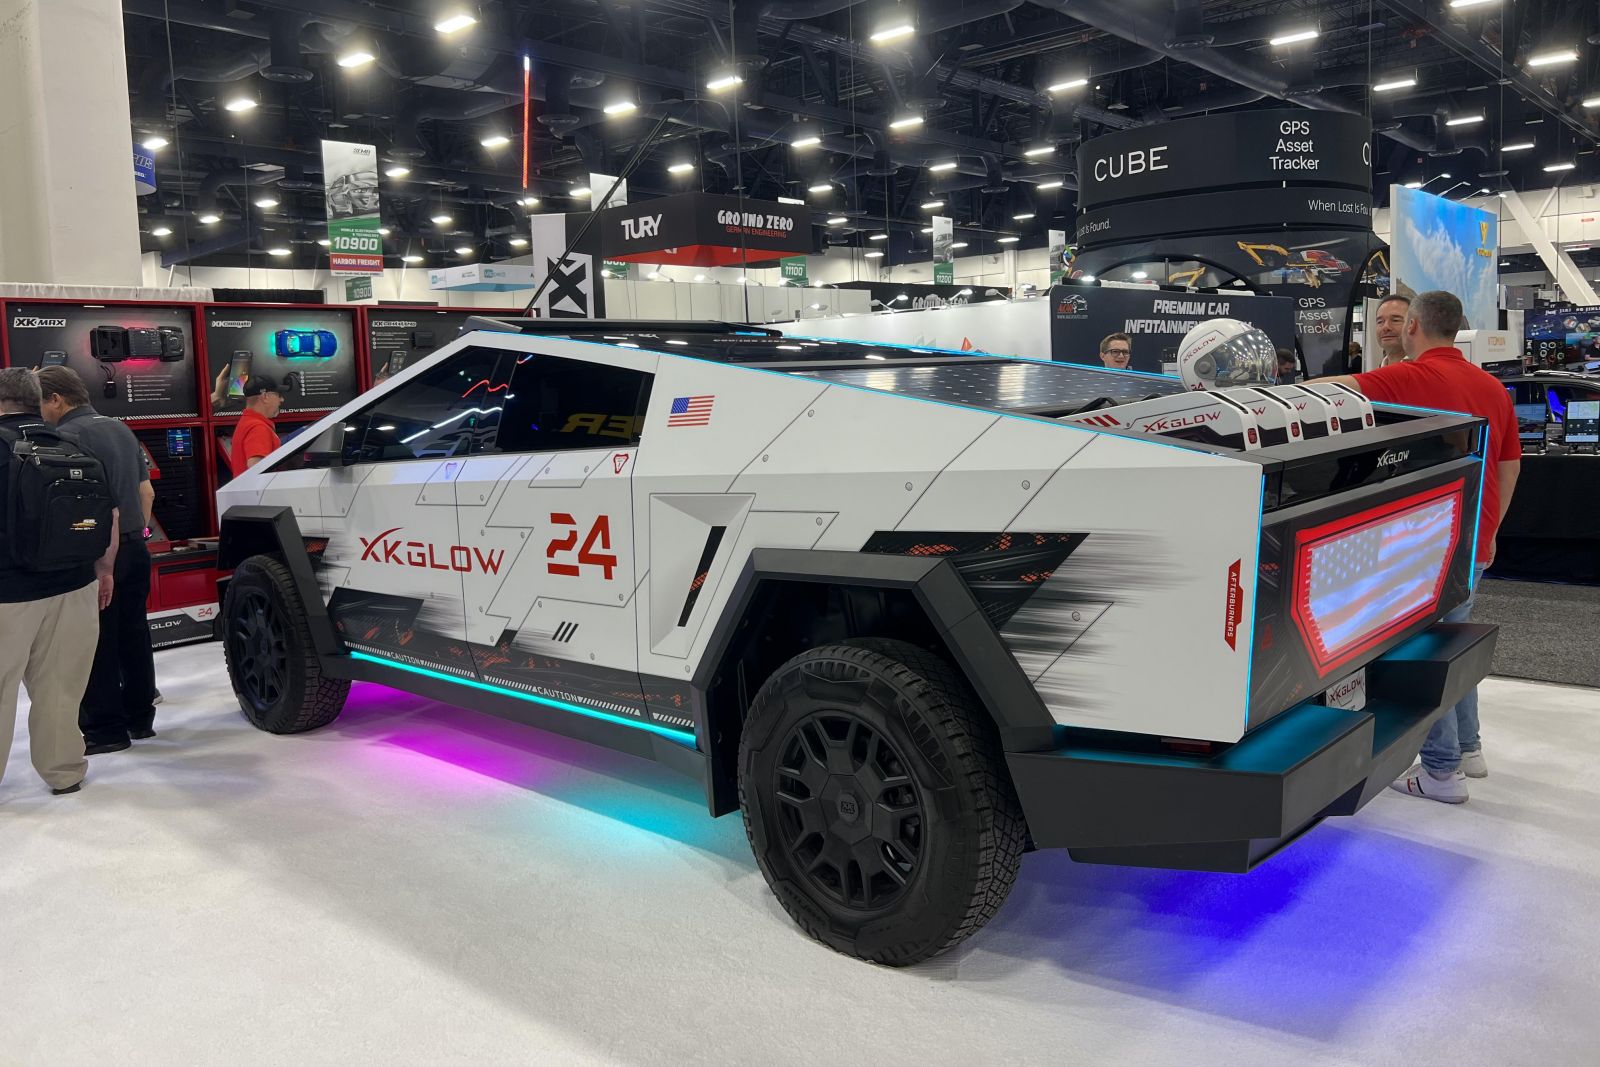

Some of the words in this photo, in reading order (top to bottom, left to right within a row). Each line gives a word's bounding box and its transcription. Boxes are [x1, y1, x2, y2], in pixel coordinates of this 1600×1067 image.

[1280, 121, 1310, 135] GPS
[1275, 138, 1314, 153] Asset
[1094, 145, 1169, 182] CUBE
[1269, 155, 1320, 171] Tracker
[1308, 199, 1336, 212] When
[1338, 201, 1354, 214] Lost
[621, 213, 663, 241] TURY
[717, 210, 763, 228] GROUND
[766, 214, 794, 231] ZERO
[1090, 218, 1112, 232] Found.
[334, 236, 378, 251] 10900
[332, 257, 357, 265] HARBOR
[784, 265, 803, 276] 11100
[1153, 299, 1206, 316] PREMIUM
[1207, 302, 1230, 316] CAR
[1298, 297, 1326, 308] GPS
[1299, 309, 1334, 321] Asset
[1295, 322, 1342, 334] Tracker
[1143, 410, 1222, 433] XKGLOW
[1376, 449, 1410, 468] XKGLOW
[359, 526, 505, 576] XKGLOW
[546, 512, 618, 581] 24
[1227, 571, 1237, 637] AFTERBURNERS
[198, 607, 213, 617] 24
[150, 620, 181, 630] GLOW
[389, 651, 421, 666] CAUTION
[536, 685, 579, 703] CAUTION
